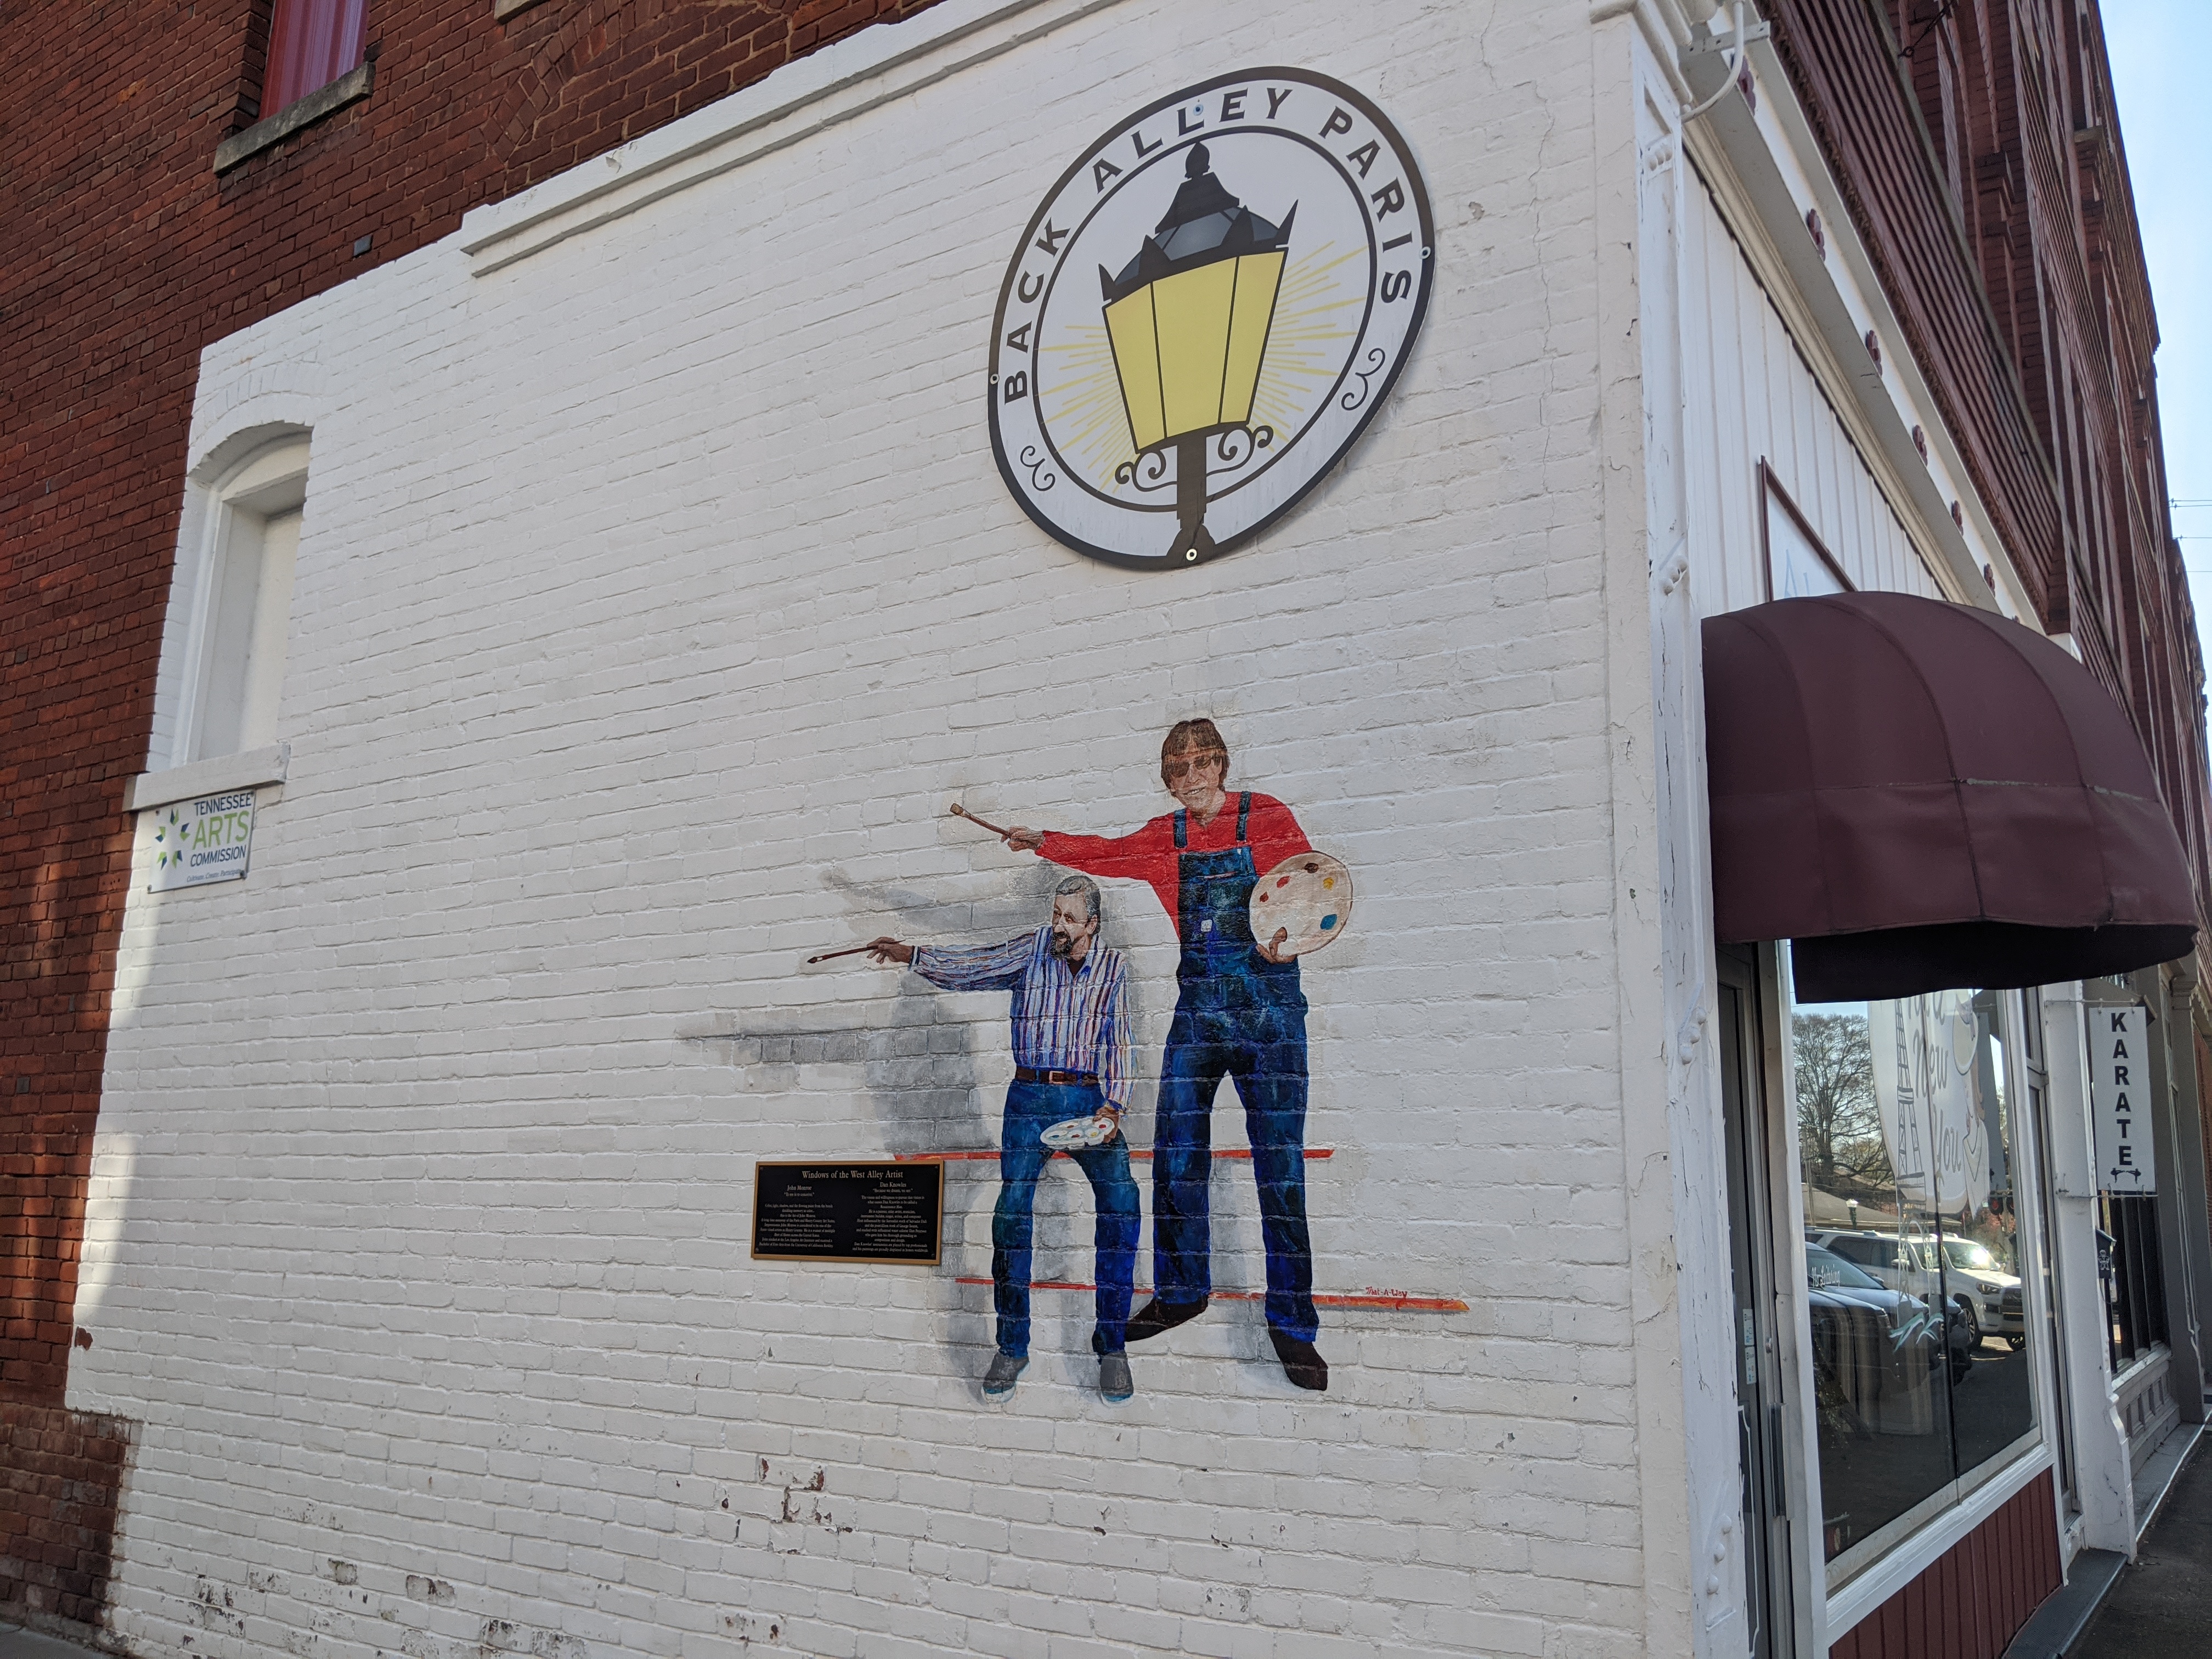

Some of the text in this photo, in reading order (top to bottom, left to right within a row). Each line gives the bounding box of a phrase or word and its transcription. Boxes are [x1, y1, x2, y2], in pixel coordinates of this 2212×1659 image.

[1005, 87, 1414, 404] BACK ALLEY PARIS
[192, 810, 250, 850] ARTS
[194, 792, 252, 816] TENNESSEE
[190, 845, 246, 867] COMMISSION
[1913, 1029, 1948, 1098] New
[2111, 1012, 2134, 1166] KARATE
[1933, 1103, 1961, 1173] You
[867, 1171, 883, 1179] Alley
